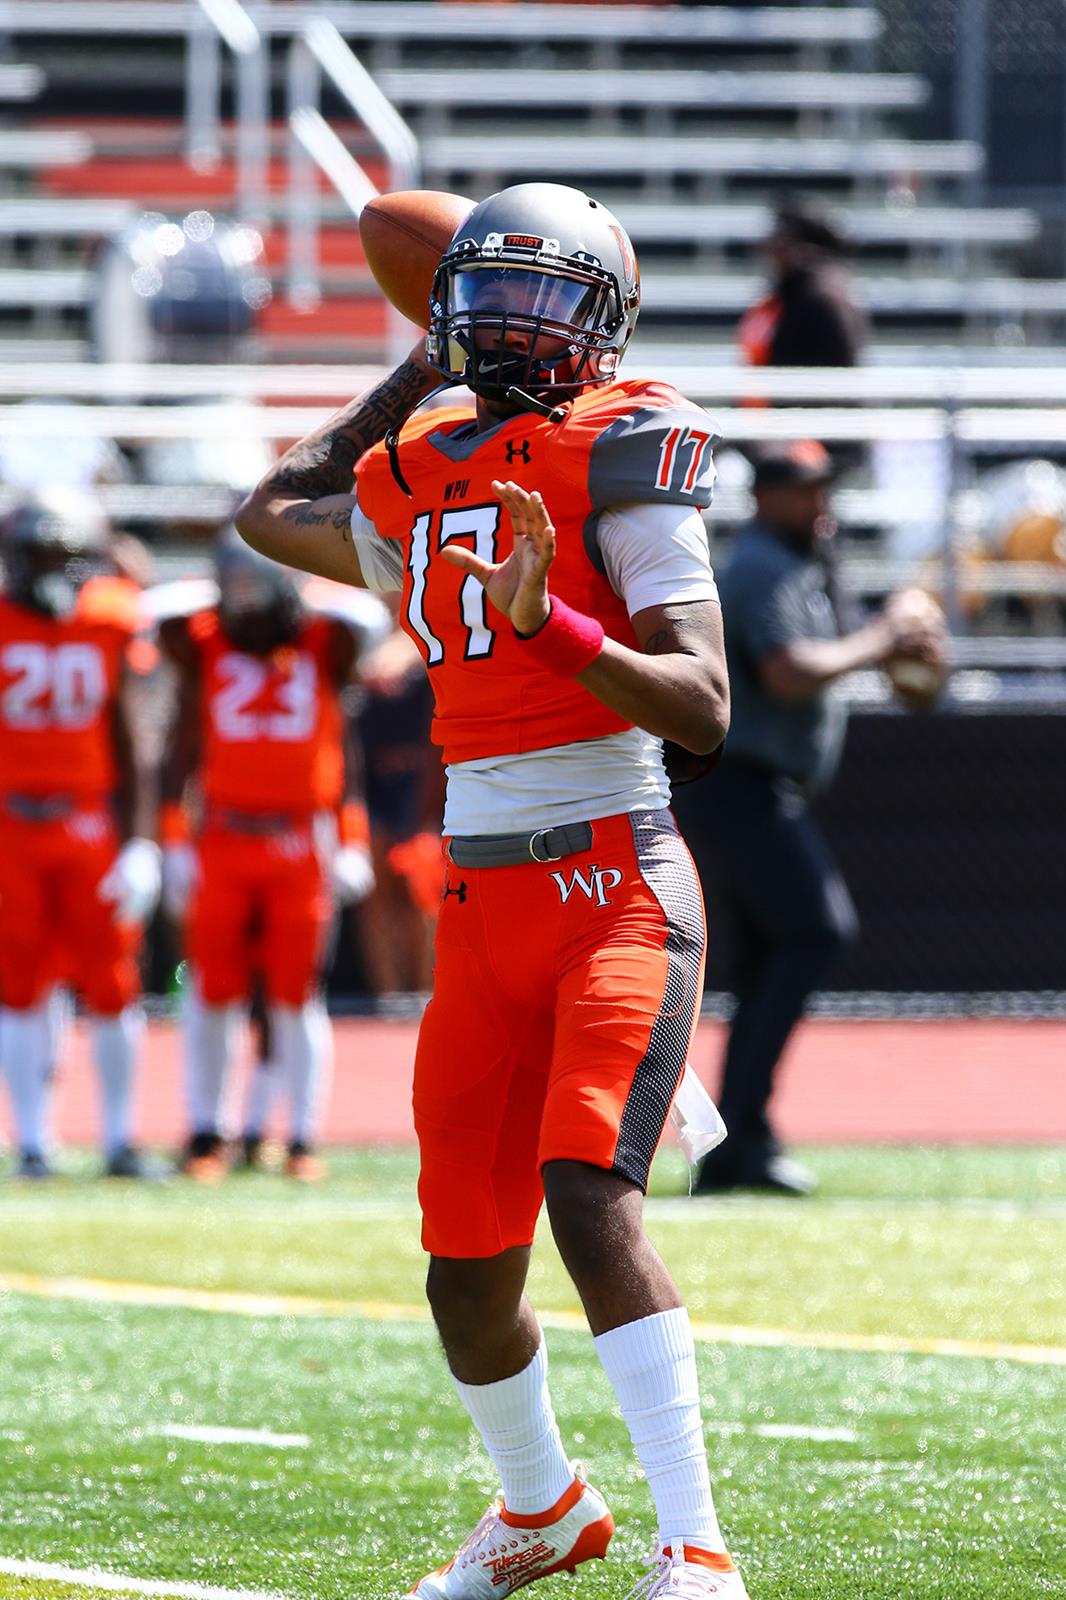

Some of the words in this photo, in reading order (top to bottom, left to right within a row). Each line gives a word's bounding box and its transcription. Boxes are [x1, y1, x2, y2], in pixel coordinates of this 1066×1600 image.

[506, 235, 541, 248] TRUST
[443, 479, 471, 501] WPU
[654, 426, 713, 495] 17
[407, 502, 501, 669] 17
[2, 642, 107, 732] 20
[212, 651, 317, 742] 23
[548, 864, 623, 907] WP
